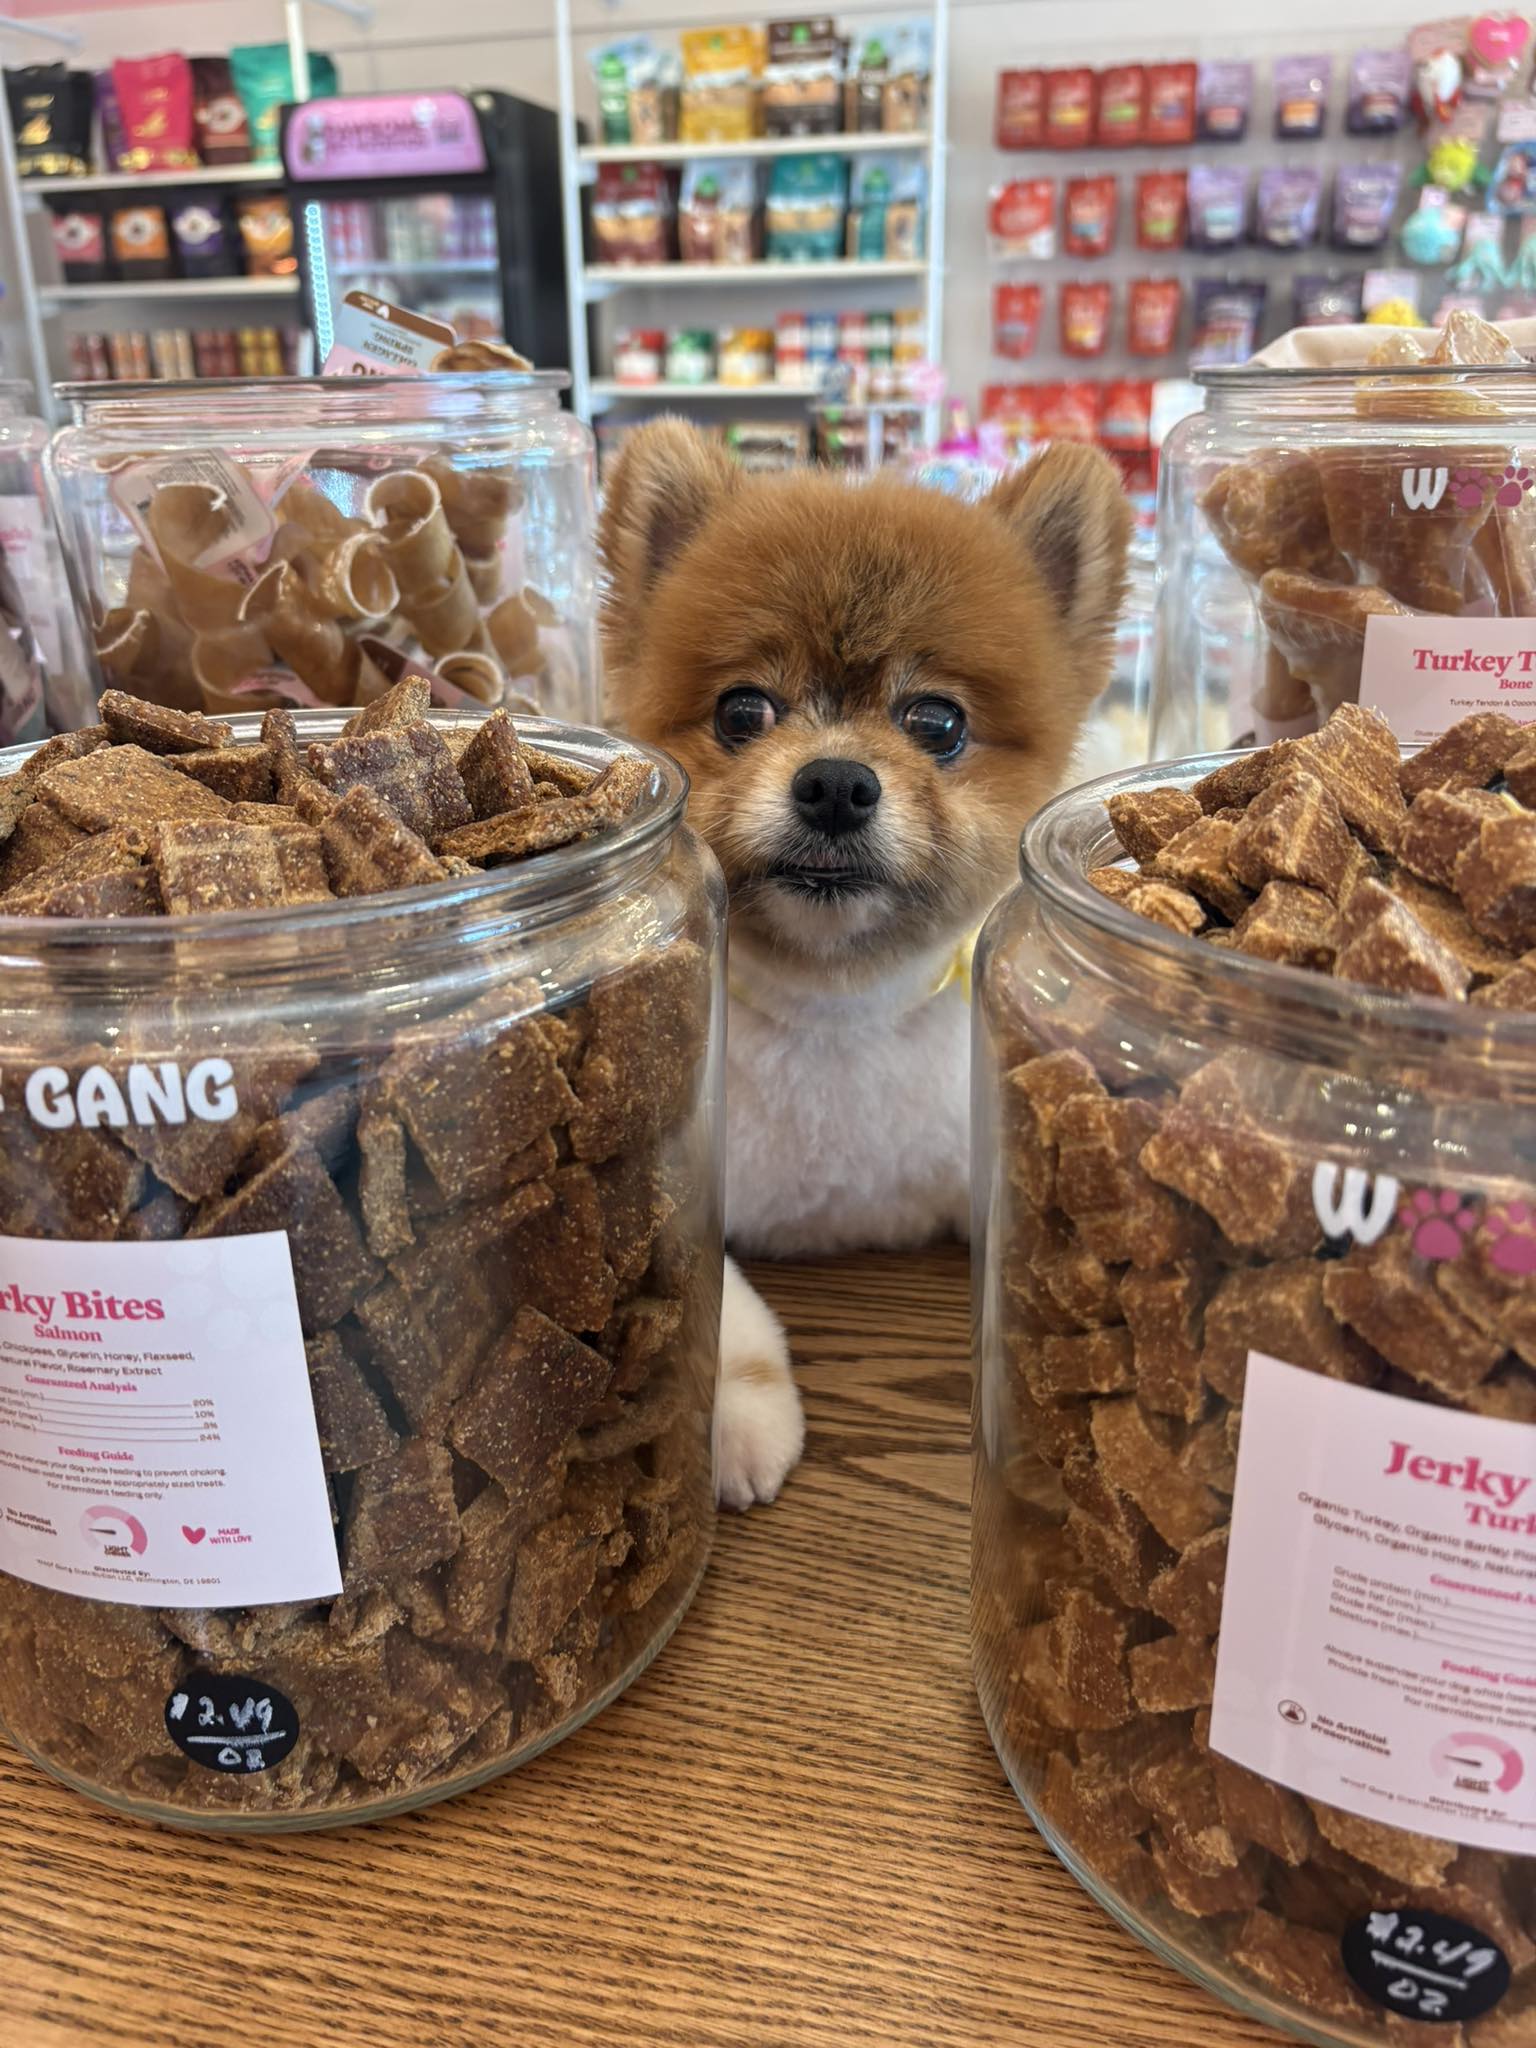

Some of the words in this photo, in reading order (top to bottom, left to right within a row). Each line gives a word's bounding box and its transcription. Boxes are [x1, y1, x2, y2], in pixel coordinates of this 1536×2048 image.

[1413, 649, 1513, 678] Turkey
[1518, 650, 1536, 672] T
[1498, 679, 1533, 690] Bone
[1450, 699, 1474, 707] Turkey
[25, 1058, 238, 1129] GANG
[1312, 1161, 1399, 1246] W
[61, 1290, 165, 1320] Bites
[34, 1324, 103, 1342] Salmon
[104, 1351, 142, 1363] Honey,
[67, 1364, 119, 1376] Rosemary
[122, 1366, 163, 1376] Extract
[90, 1381, 138, 1394] Analysis
[57, 1446, 100, 1461] Feeding
[101, 1450, 134, 1461] Guide
[109, 1467, 142, 1478] feeding
[143, 1469, 153, 1477] to
[154, 1470, 188, 1478] prevent
[1384, 1440, 1531, 1508] Jerky
[111, 1489, 143, 1500] feeding
[217, 1528, 240, 1536] MADE
[1298, 1491, 1350, 1517] Organic
[1352, 1509, 1401, 1533] Turkey,
[1404, 1524, 1461, 1548] Organic
[1464, 1540, 1510, 1559] Barley
[209, 1537, 232, 1545] WITH
[233, 1535, 253, 1544] LOVE
[1313, 1512, 1371, 1542] Glycerin,
[1374, 1532, 1429, 1557] Organic
[1431, 1549, 1480, 1570] Honey,
[1484, 1559, 1536, 1580] Natura
[1441, 1659, 1500, 1684] Feeding
[1317, 1713, 1335, 1728] No
[1336, 1721, 1388, 1745] Artificial
